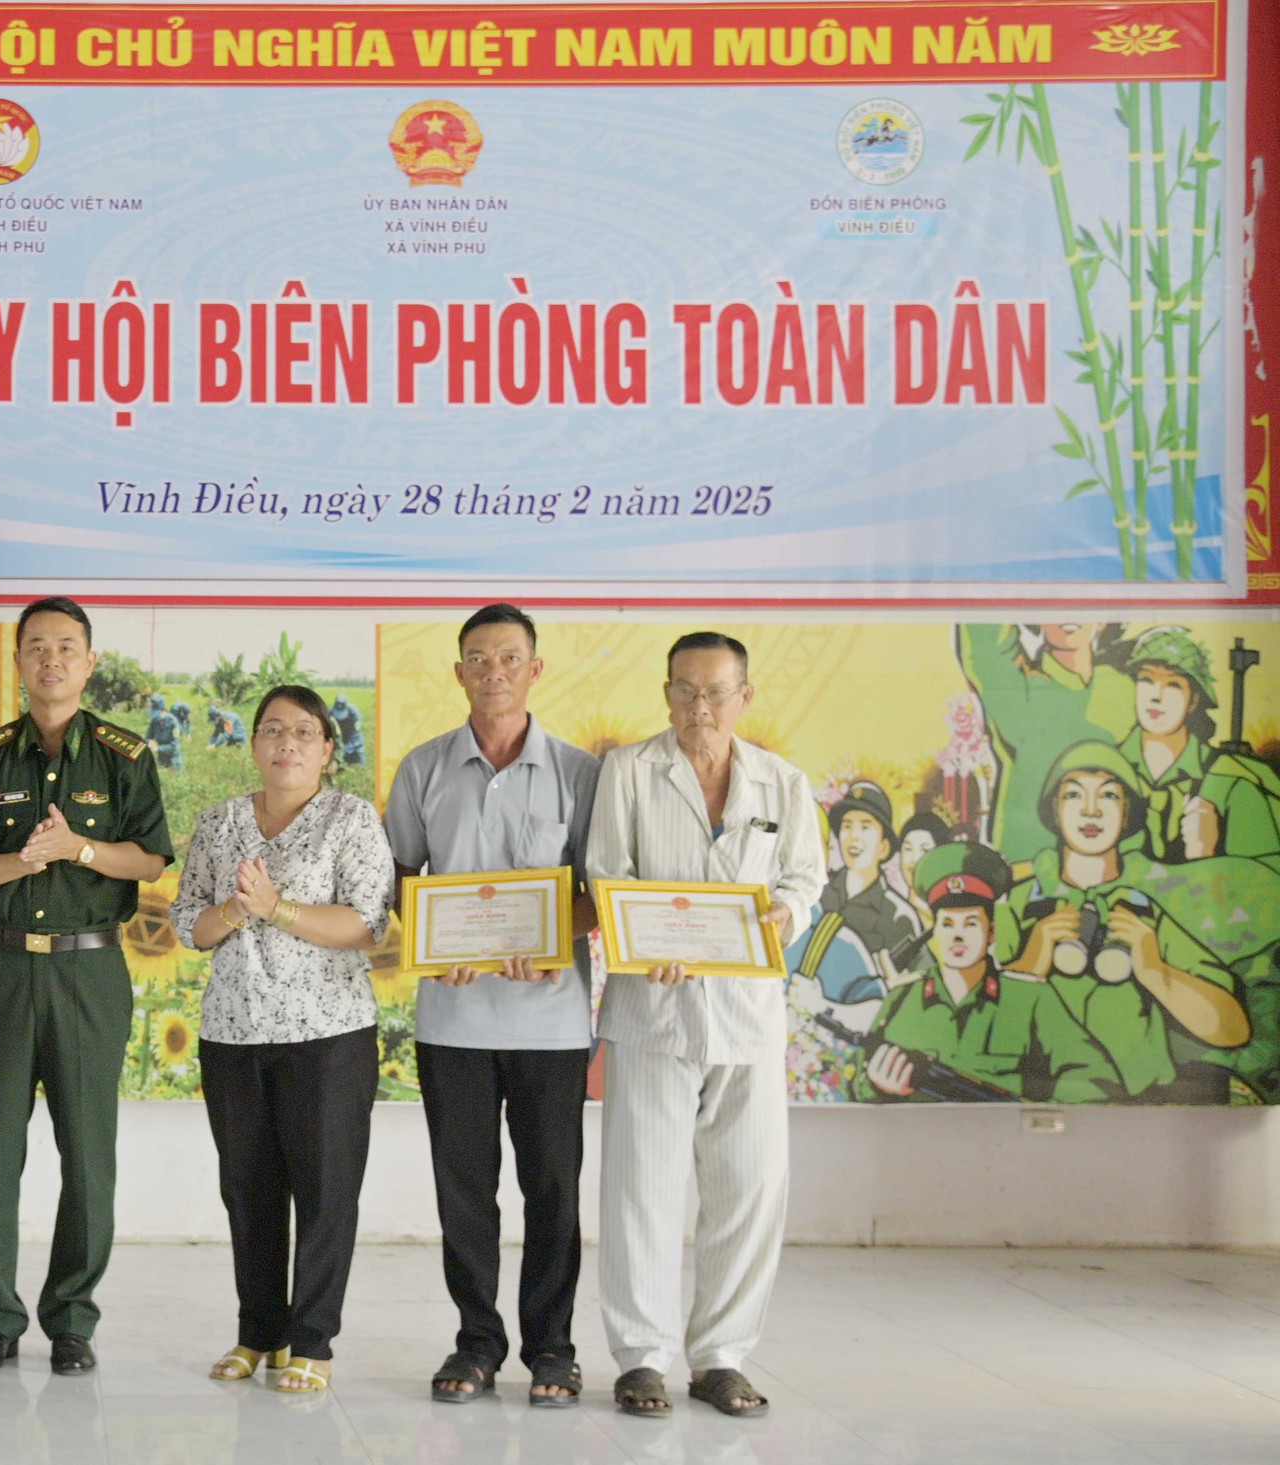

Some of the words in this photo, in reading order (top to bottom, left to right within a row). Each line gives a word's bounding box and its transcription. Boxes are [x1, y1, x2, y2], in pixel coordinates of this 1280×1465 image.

[76, 16, 192, 67] CHỦ
[213, 21, 395, 67] NGHĨA
[412, 21, 537, 76] VIỆT
[555, 28, 693, 67] NAM
[713, 18, 892, 66] MUÔN
[912, 16, 1052, 64] NĂM
[21, 194, 65, 210] QUỐC
[70, 196, 104, 211] VIỆT
[109, 199, 143, 211] NAM
[51, 280, 170, 427] HỘI
[199, 280, 368, 404] BIÊN
[397, 277, 647, 405] PHÒNG
[673, 281, 865, 405] TOÀN
[894, 280, 1046, 405] DÂN
[97, 480, 180, 515] Vĩnh
[192, 475, 289, 518] Điều,
[300, 483, 391, 522] ngày
[400, 484, 443, 516] 28
[454, 483, 562, 522] tháng
[568, 485, 591, 516] 2
[601, 486, 680, 517] năm
[691, 485, 774, 517] 2025
